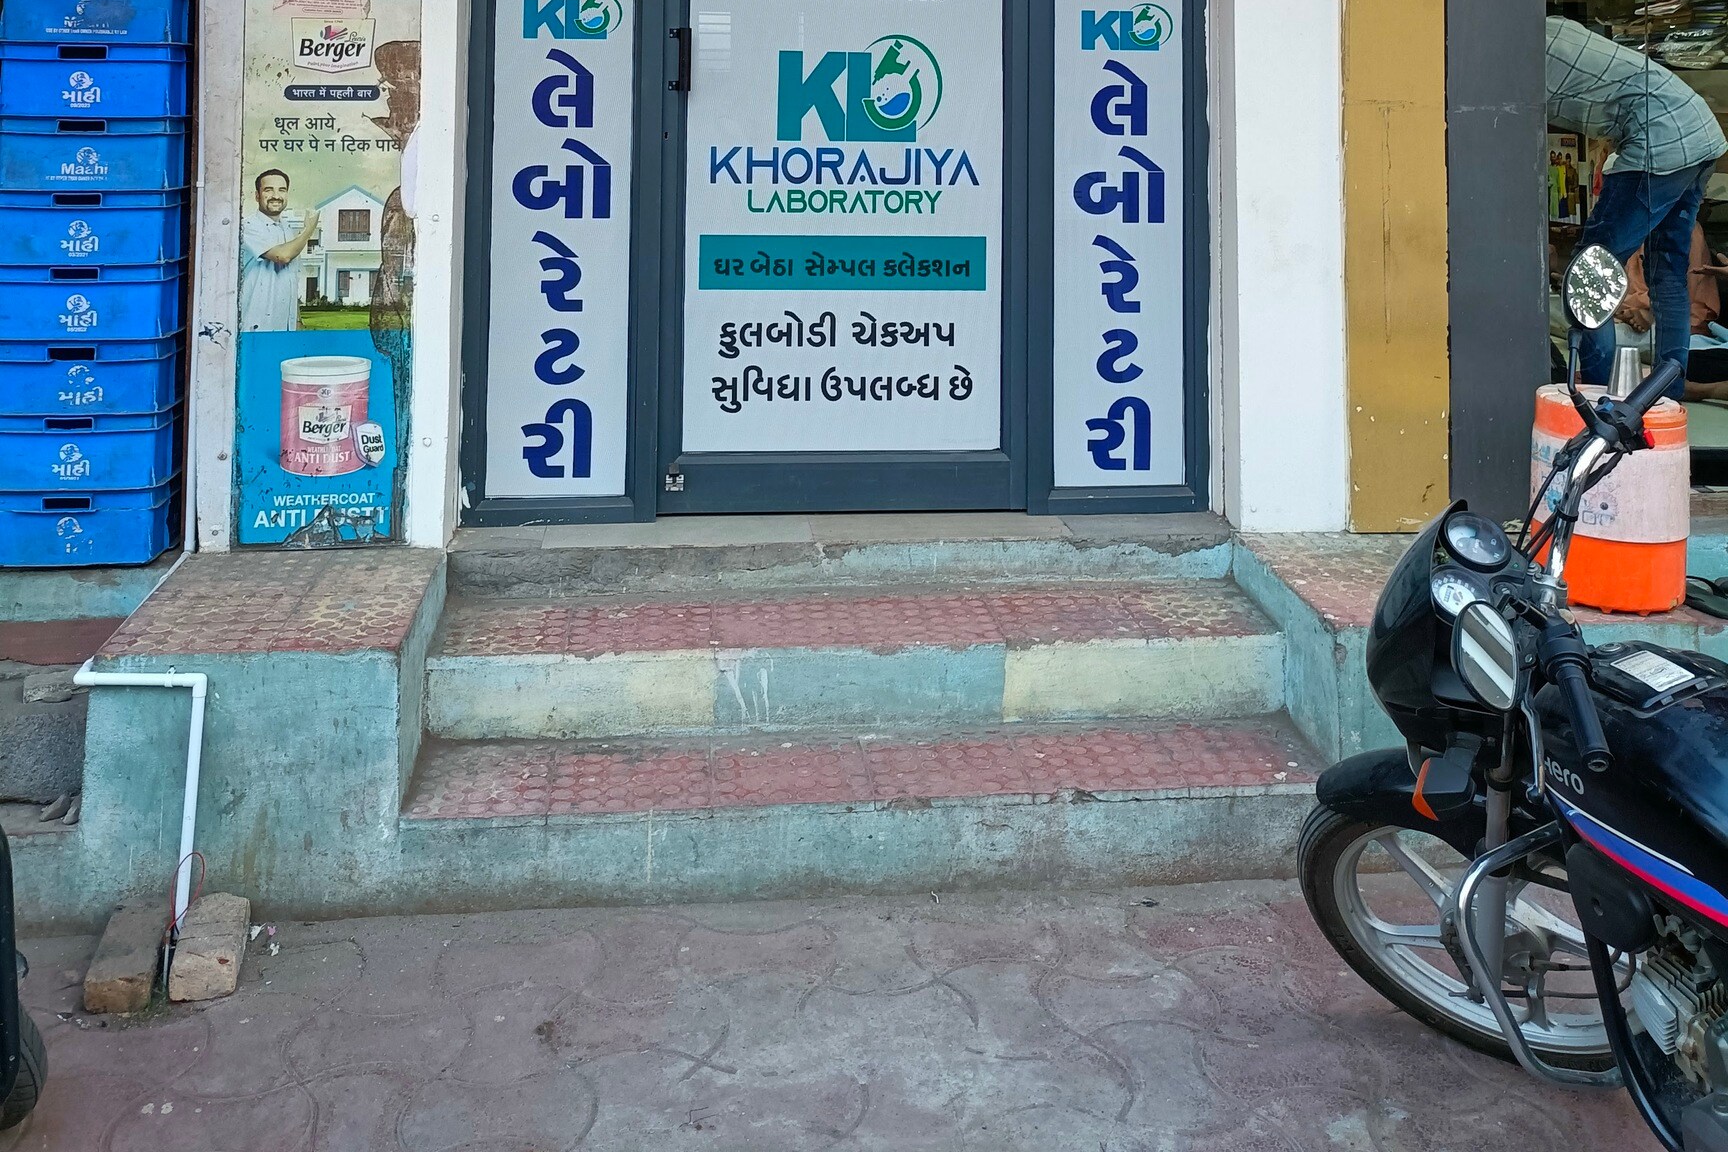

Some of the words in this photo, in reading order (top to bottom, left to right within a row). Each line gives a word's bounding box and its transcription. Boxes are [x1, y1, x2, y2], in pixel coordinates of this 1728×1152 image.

[299, 38, 366, 62] Berger
[62, 87, 101, 103] માહી
[292, 88, 315, 98] भारत
[318, 86, 327, 98] में
[329, 86, 353, 100] पहली
[357, 89, 372, 98] बार
[274, 116, 300, 135] धूल
[259, 139, 279, 152] पर
[283, 139, 304, 152] घर
[309, 134, 320, 152] पे
[324, 139, 336, 152] न
[710, 147, 980, 186] KHORAJIYA
[747, 190, 943, 214] LABORATORY
[60, 236, 99, 252] માહી
[714, 258, 744, 277] ઘર
[751, 251, 793, 277] બેઠા
[805, 251, 875, 277] સેમ્પલ
[884, 251, 970, 278] કલેકશન
[58, 310, 98, 327] માહી
[852, 311, 955, 347] ચેકઅપ
[711, 365, 811, 413] સુવિધા
[821, 366, 940, 401] ઉપલબ્ધ
[949, 365, 973, 401] છે
[302, 420, 347, 437] Berger
[361, 434, 382, 444] Dust
[294, 452, 322, 463] ANTI
[363, 445, 384, 453] Guard
[51, 459, 90, 476] માહી
[273, 493, 375, 507] WEATHERCOAT
[253, 509, 305, 528] ANTI
